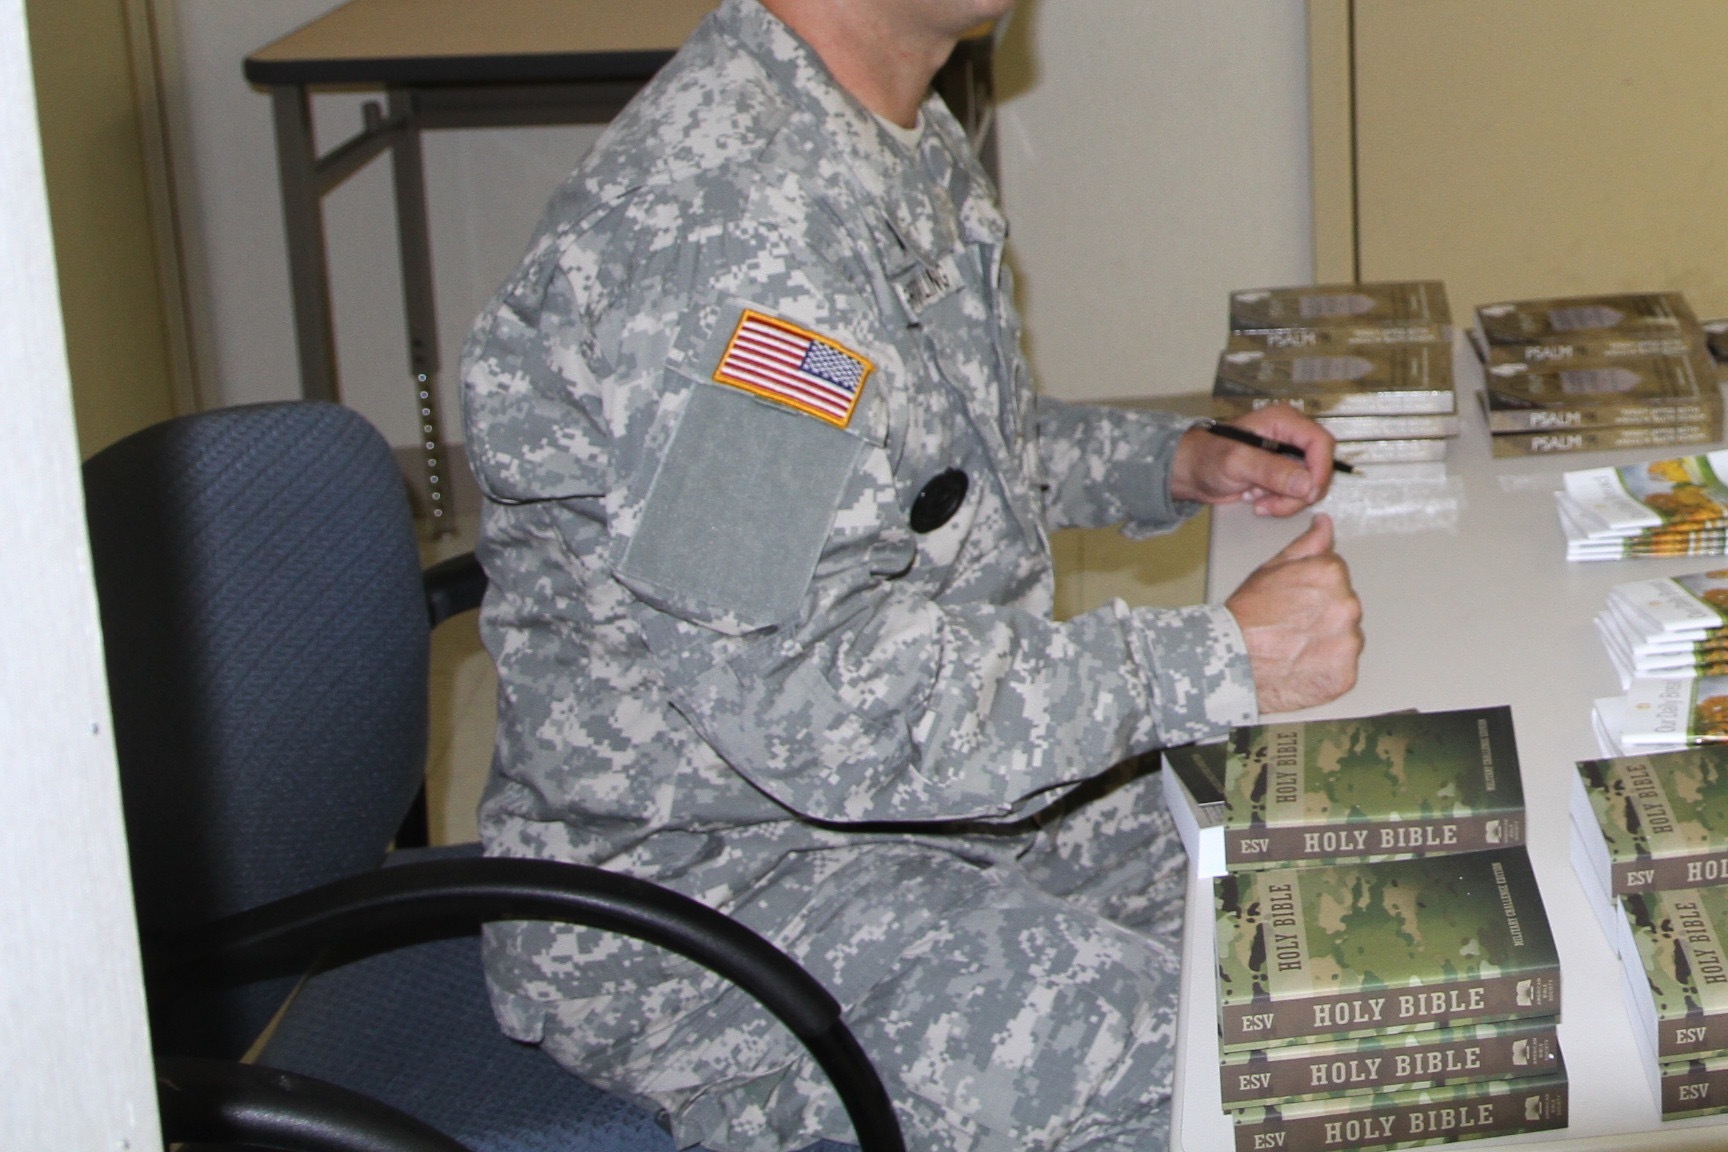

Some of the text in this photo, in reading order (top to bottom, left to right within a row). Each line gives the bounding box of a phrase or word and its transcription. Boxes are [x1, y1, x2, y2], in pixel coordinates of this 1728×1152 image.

[1525, 345, 1574, 362] PSALM
[1530, 410, 1582, 427] PSALM
[1531, 434, 1583, 452] PSALM
[1276, 732, 1297, 803] HOLY BIBLE
[1626, 764, 1674, 834] HOLY BIBLE
[1241, 839, 1269, 853] ESV
[1304, 824, 1457, 852] HOLY BIBLE
[1627, 870, 1655, 886] ESV
[1269, 884, 1302, 972] HOLY BIBLE
[1675, 902, 1728, 985] HOLY BIBLE
[1313, 987, 1485, 1027] HOLY BIBLE
[1242, 1013, 1274, 1032] ESV
[1676, 1026, 1707, 1045] ESV
[1310, 1047, 1481, 1086] HOLY BIBLE
[1239, 1073, 1271, 1090] ESV
[1679, 1083, 1709, 1101] ESV
[1325, 1103, 1494, 1144] HOLY BIBLE
[1254, 1132, 1286, 1149] ESV
